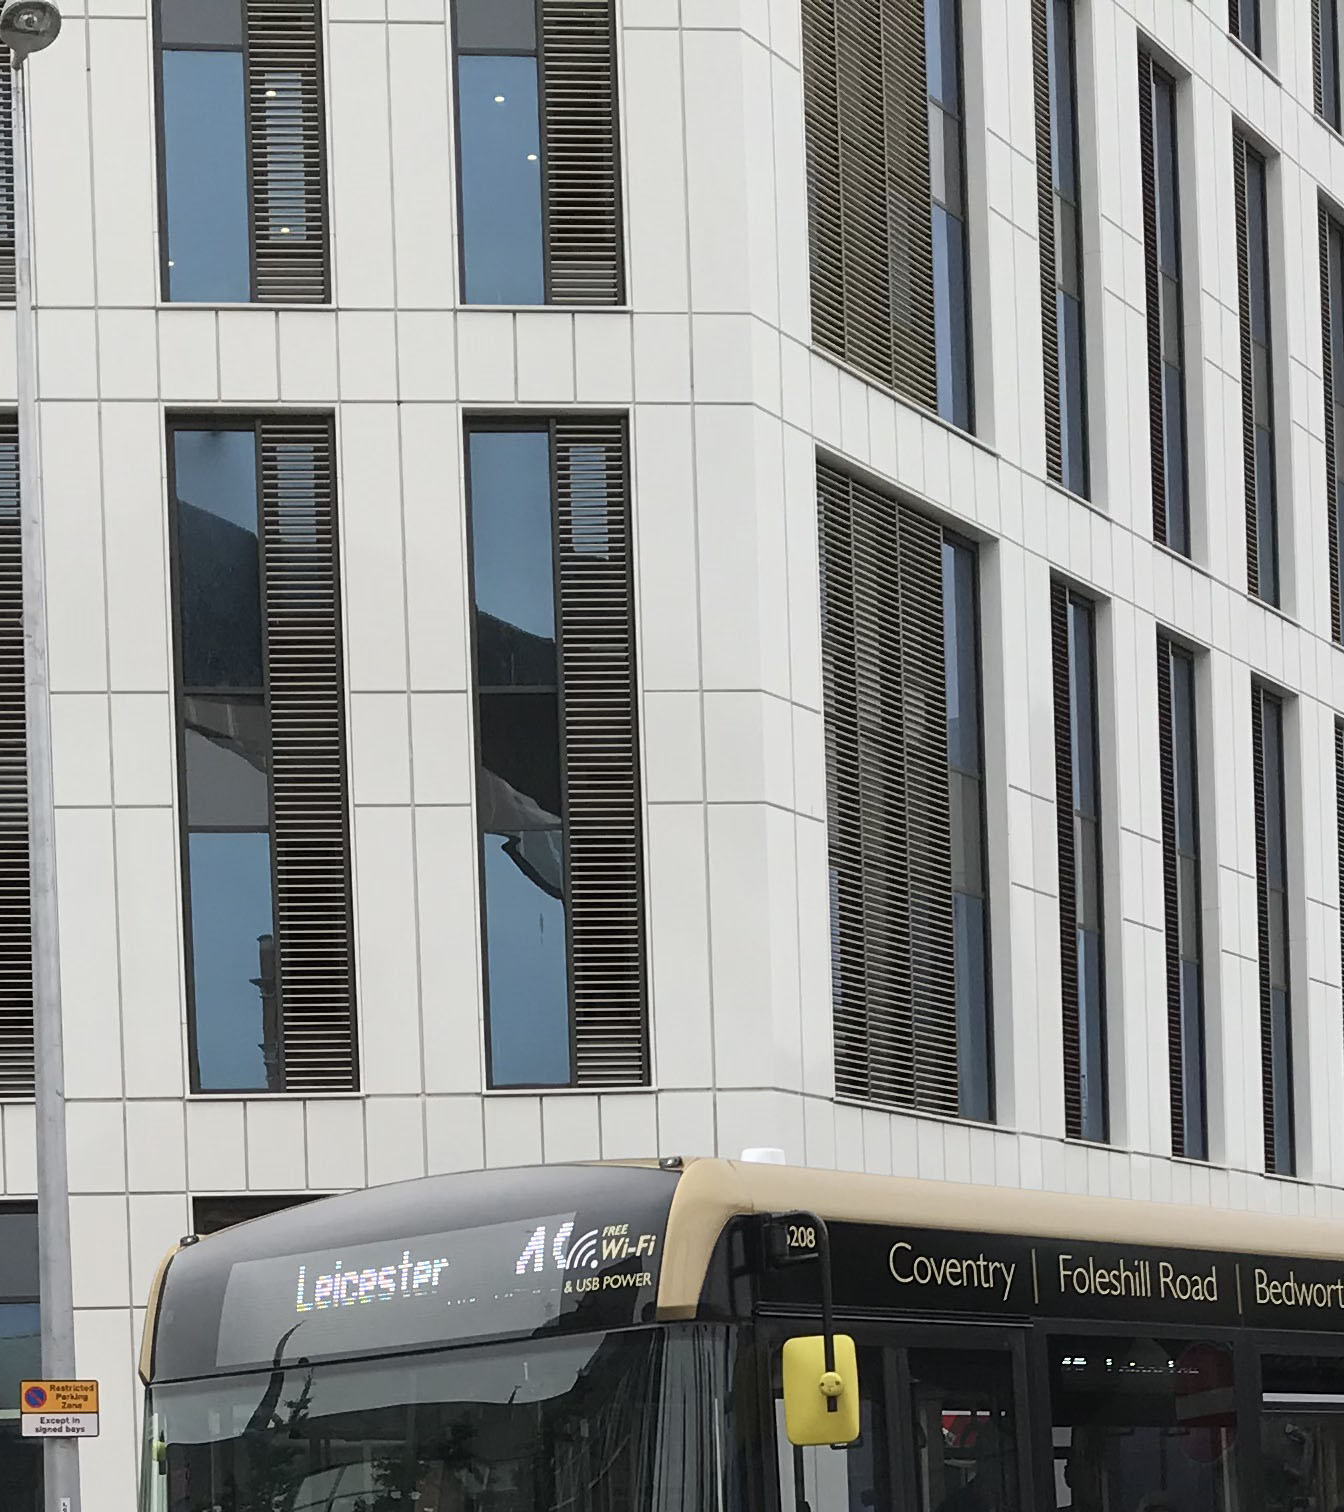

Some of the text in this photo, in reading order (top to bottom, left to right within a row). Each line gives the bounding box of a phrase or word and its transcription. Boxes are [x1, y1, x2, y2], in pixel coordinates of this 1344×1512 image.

[601, 1223, 629, 1237] FREE
[601, 1234, 656, 1261] Wi-Fi
[888, 1241, 1016, 1301] Coventry
[1058, 1255, 1152, 1298] Foleshill
[1159, 1262, 1218, 1302] Road
[296, 1250, 449, 1312] Leicester
[563, 1272, 652, 1294] & USB POWER
[50, 1384, 94, 1393] Restricted
[55, 1393, 88, 1402] Parking
[61, 1402, 82, 1410] Zone
[40, 1416, 80, 1425] Except in
[35, 1425, 85, 1434] signed bays
